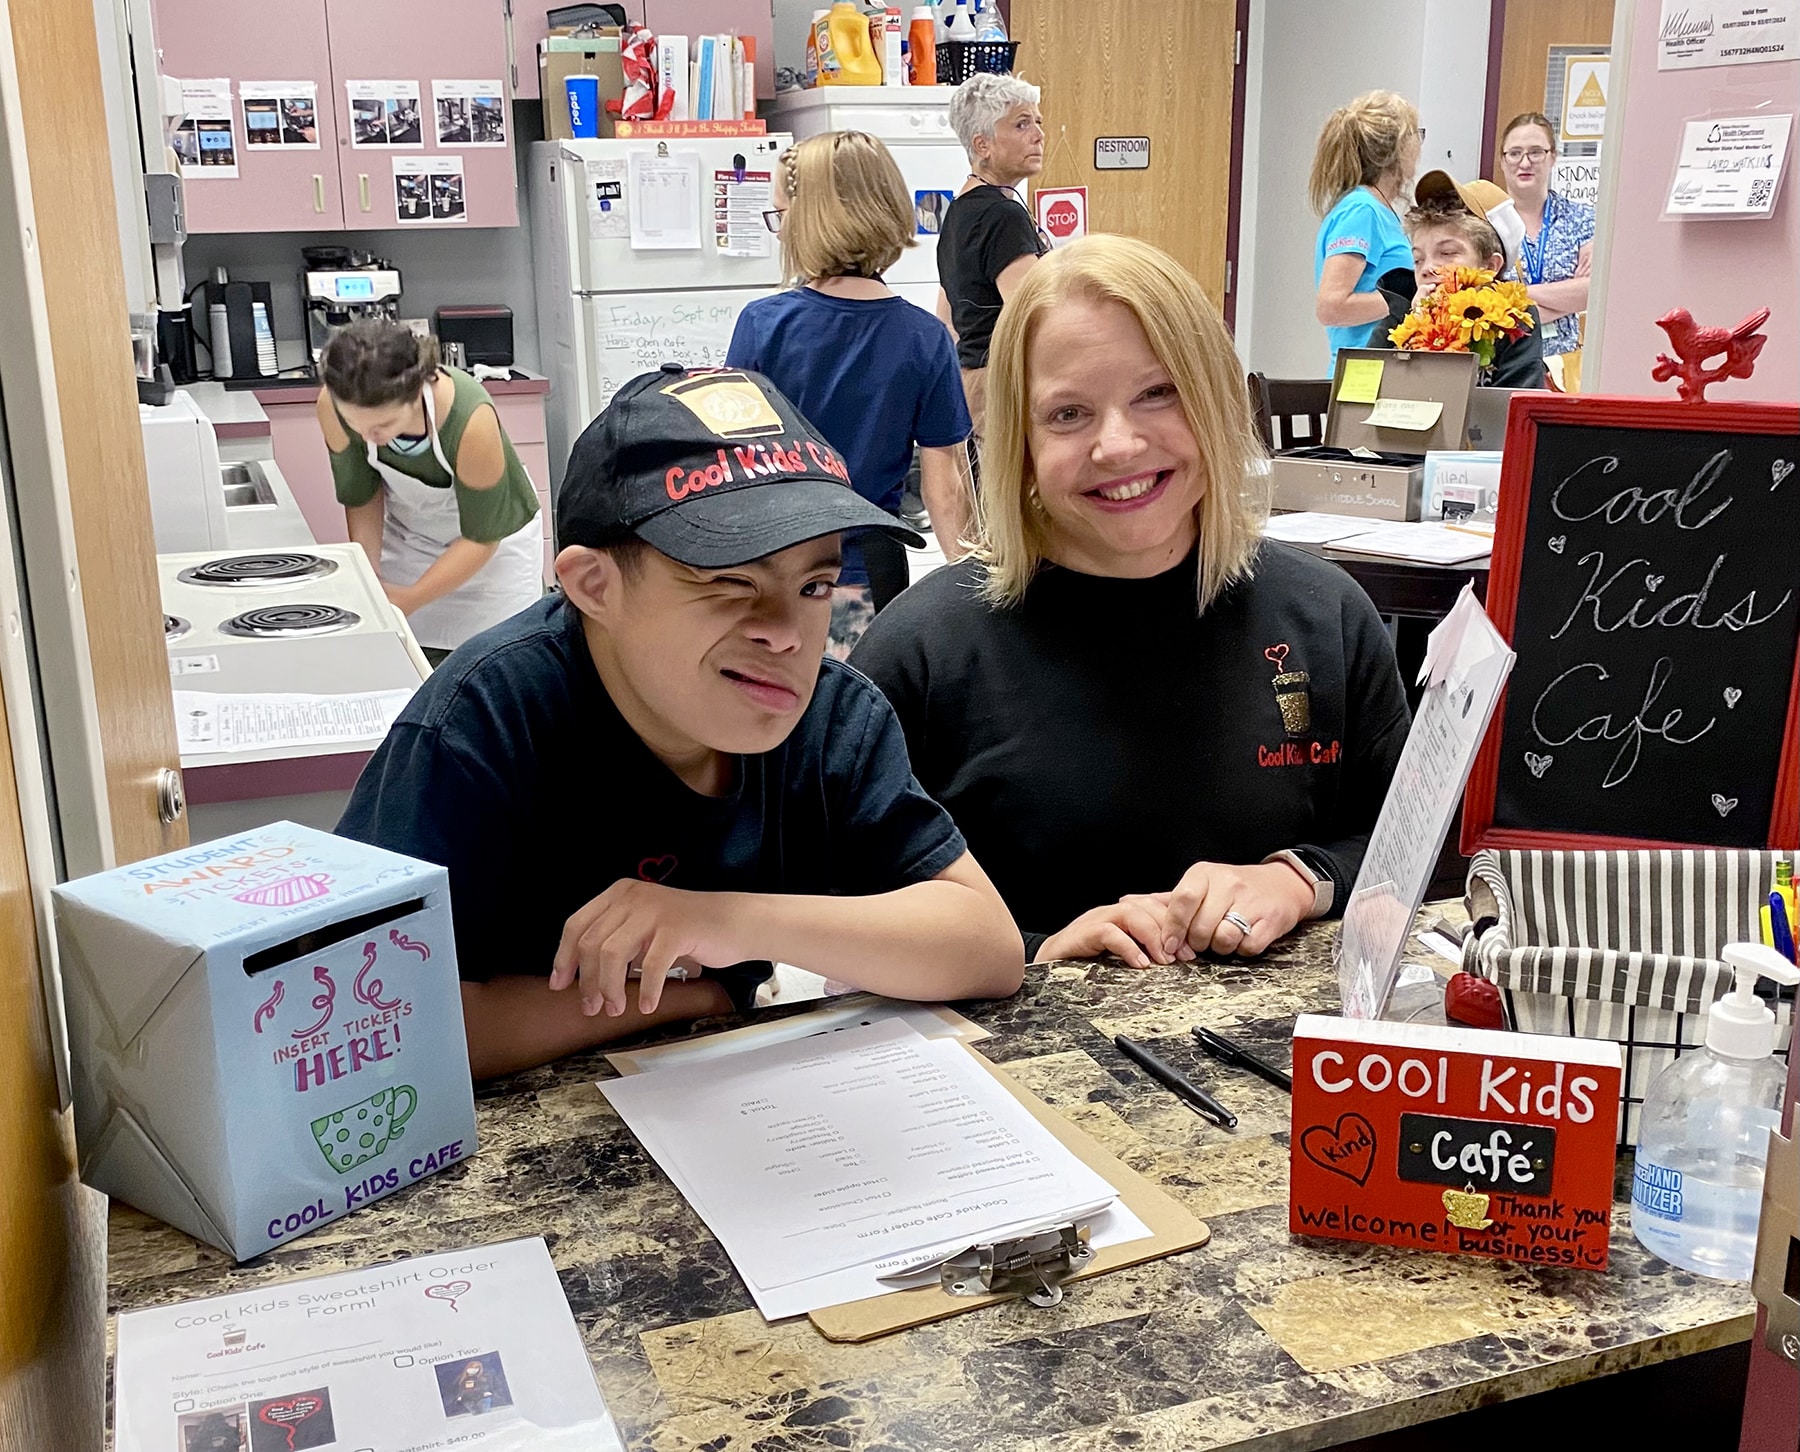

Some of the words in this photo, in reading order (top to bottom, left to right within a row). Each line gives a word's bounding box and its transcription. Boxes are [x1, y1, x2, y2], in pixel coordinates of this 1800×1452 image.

[1686, 38, 1706, 46] Officer
[568, 91, 584, 126] pepsi
[712, 121, 738, 136] Happy
[1098, 140, 1148, 153] RESTROOM
[1559, 182, 1599, 207] chang
[1047, 212, 1077, 227] STOP
[671, 304, 704, 325] Sept
[636, 336, 660, 349] Open
[665, 448, 734, 501] Cool
[733, 439, 808, 480] Kids'
[1551, 449, 1734, 530] Cool
[1550, 551, 1794, 640] Kids
[1532, 656, 1717, 789] Cafe
[1257, 744, 1285, 768] Cool
[128, 837, 255, 881] STUDENT
[143, 846, 295, 895] AWARD
[178, 860, 308, 901] TICKETS
[213, 916, 269, 940] INSERT
[281, 895, 337, 919] TICKETS
[273, 1031, 331, 1065] INSERT
[343, 1002, 413, 1036] TICKETS
[294, 1022, 402, 1093] HERE!
[1312, 1051, 1448, 1104] Cool
[1479, 1059, 1599, 1123] Kids
[818, 1149, 848, 1160] Lemon
[987, 1140, 1010, 1149] Latte
[1321, 1126, 1372, 1163] Kind
[1005, 1153, 1022, 1161] Add
[1005, 1159, 1031, 1168] Fresh
[1431, 1129, 1535, 1183] Café
[947, 1171, 974, 1180] coffee
[975, 1165, 1006, 1175] brewed
[1648, 1164, 1683, 1191] HAND
[267, 1198, 334, 1239] COOL
[344, 1167, 399, 1210] KIDS
[408, 1139, 464, 1179] CAFE
[836, 1183, 861, 1192] apple
[862, 1179, 880, 1187] Hot
[813, 1189, 836, 1198] cider
[864, 1193, 882, 1202] Hot
[981, 1199, 1008, 1208] Cool
[926, 1212, 953, 1223] Cafe
[1497, 1197, 1566, 1221] Thank
[1574, 1208, 1610, 1228] you
[857, 1228, 890, 1240] Form
[890, 1220, 925, 1232] Order
[1298, 1206, 1450, 1246] Welcome!
[1527, 1223, 1588, 1243] your
[1458, 1233, 1584, 1266] business!
[874, 1258, 909, 1270] Form
[175, 1309, 231, 1330] Cool
[239, 1297, 290, 1317] Kids
[298, 1271, 423, 1306] Sweatshirt
[428, 1259, 500, 1279] Order
[206, 1348, 224, 1360] Cool
[246, 1342, 266, 1353] Cafe
[418, 1351, 454, 1366] Option
[173, 1389, 204, 1401] Style:
[241, 1378, 256, 1387] the
[258, 1373, 278, 1385] logo
[279, 1369, 297, 1380] and
[298, 1364, 320, 1377] style
[321, 1361, 331, 1370] of
[332, 1352, 377, 1367] sweatshirt
[378, 1350, 395, 1361] you
[396, 1344, 422, 1356] would
[199, 1395, 237, 1409] Option
[446, 1431, 486, 1446] $40.00
